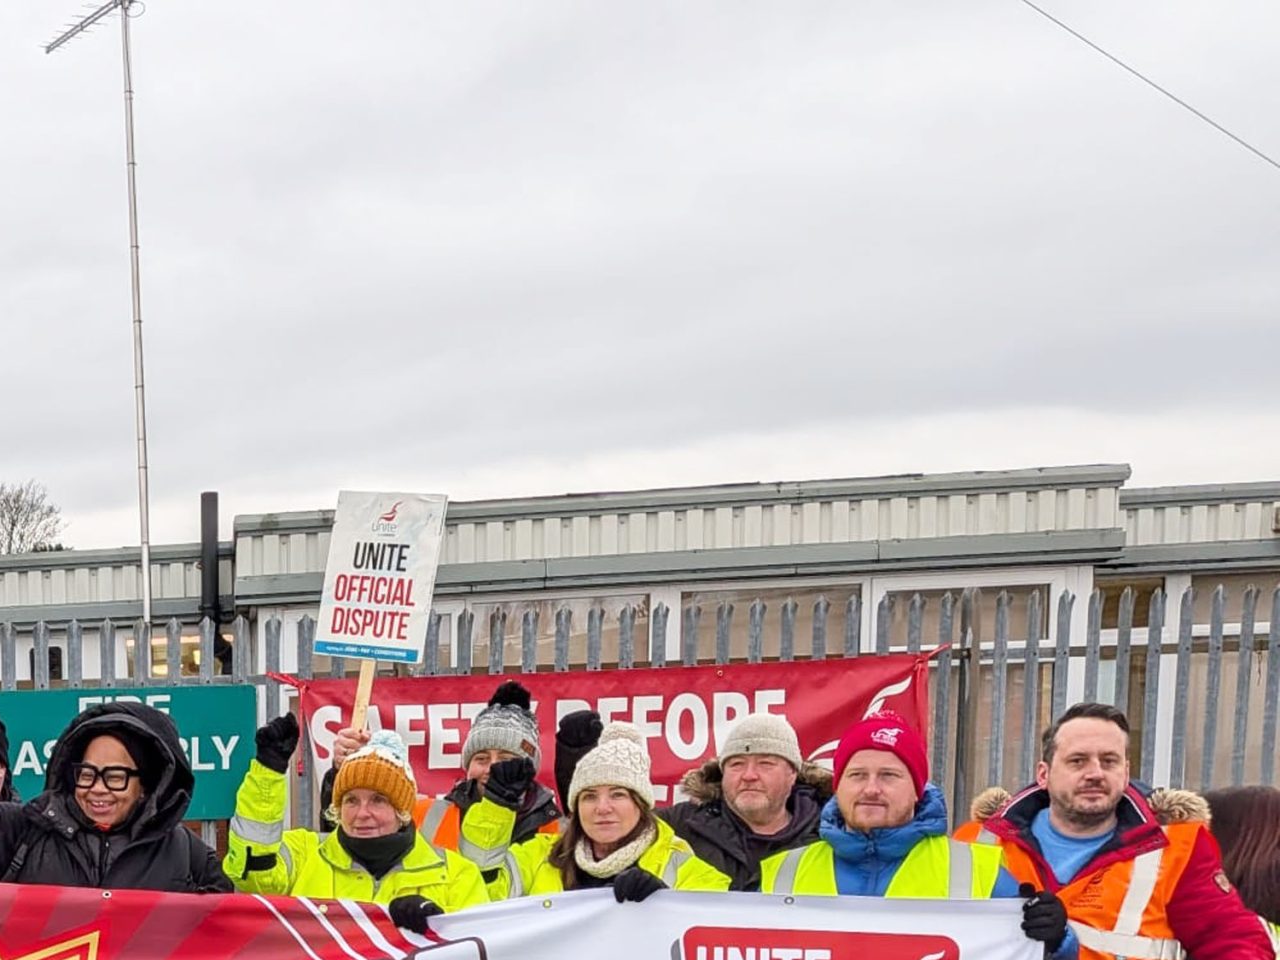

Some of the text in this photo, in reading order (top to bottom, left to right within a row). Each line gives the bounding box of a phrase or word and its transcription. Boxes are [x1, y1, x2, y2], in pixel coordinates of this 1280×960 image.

[353, 542, 410, 572] UNITE
[334, 574, 415, 606] OFFICIAL
[331, 608, 410, 640] DISPUTE
